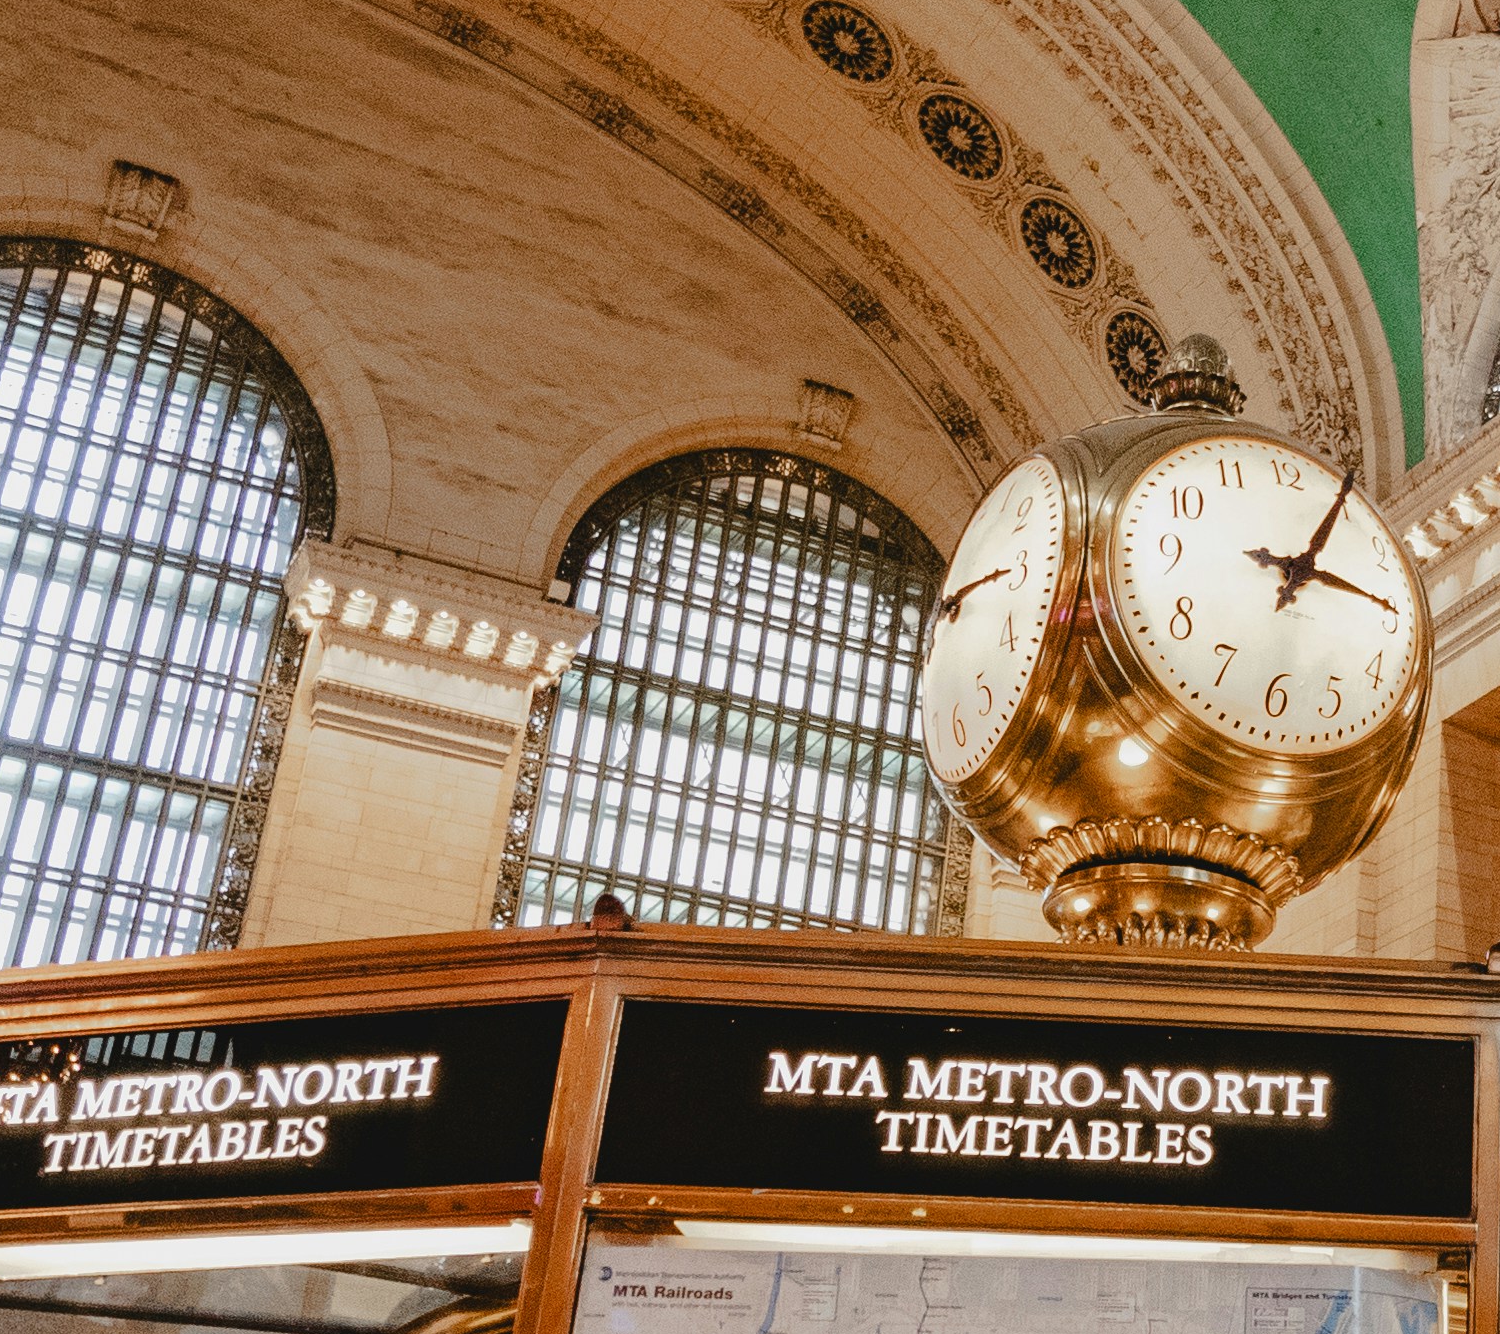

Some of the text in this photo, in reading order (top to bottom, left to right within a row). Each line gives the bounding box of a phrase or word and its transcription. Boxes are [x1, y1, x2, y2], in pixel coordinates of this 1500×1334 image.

[1216, 458, 1245, 489] 11
[1270, 459, 1305, 491] 12
[1011, 496, 1033, 535] 2
[1169, 485, 1204, 520] 10
[1008, 550, 1028, 591] 3
[1159, 533, 1183, 575] 9
[1372, 535, 1389, 572] 2
[999, 610, 1019, 653] 4
[1169, 596, 1193, 641] 8
[1213, 643, 1239, 687] 7
[1364, 649, 1384, 690] 4
[976, 671, 992, 716] 5
[1265, 673, 1292, 718] 6
[1318, 675, 1343, 719] 5
[952, 702, 966, 747] 6
[70, 1056, 440, 1121] METRO-NORTH
[764, 1052, 1330, 1118] MTA METRO-NORTH
[43, 1115, 328, 1174] TIMETABLES
[875, 1110, 1214, 1166] TIMETABLES
[612, 1284, 734, 1301] MTA Railroads
